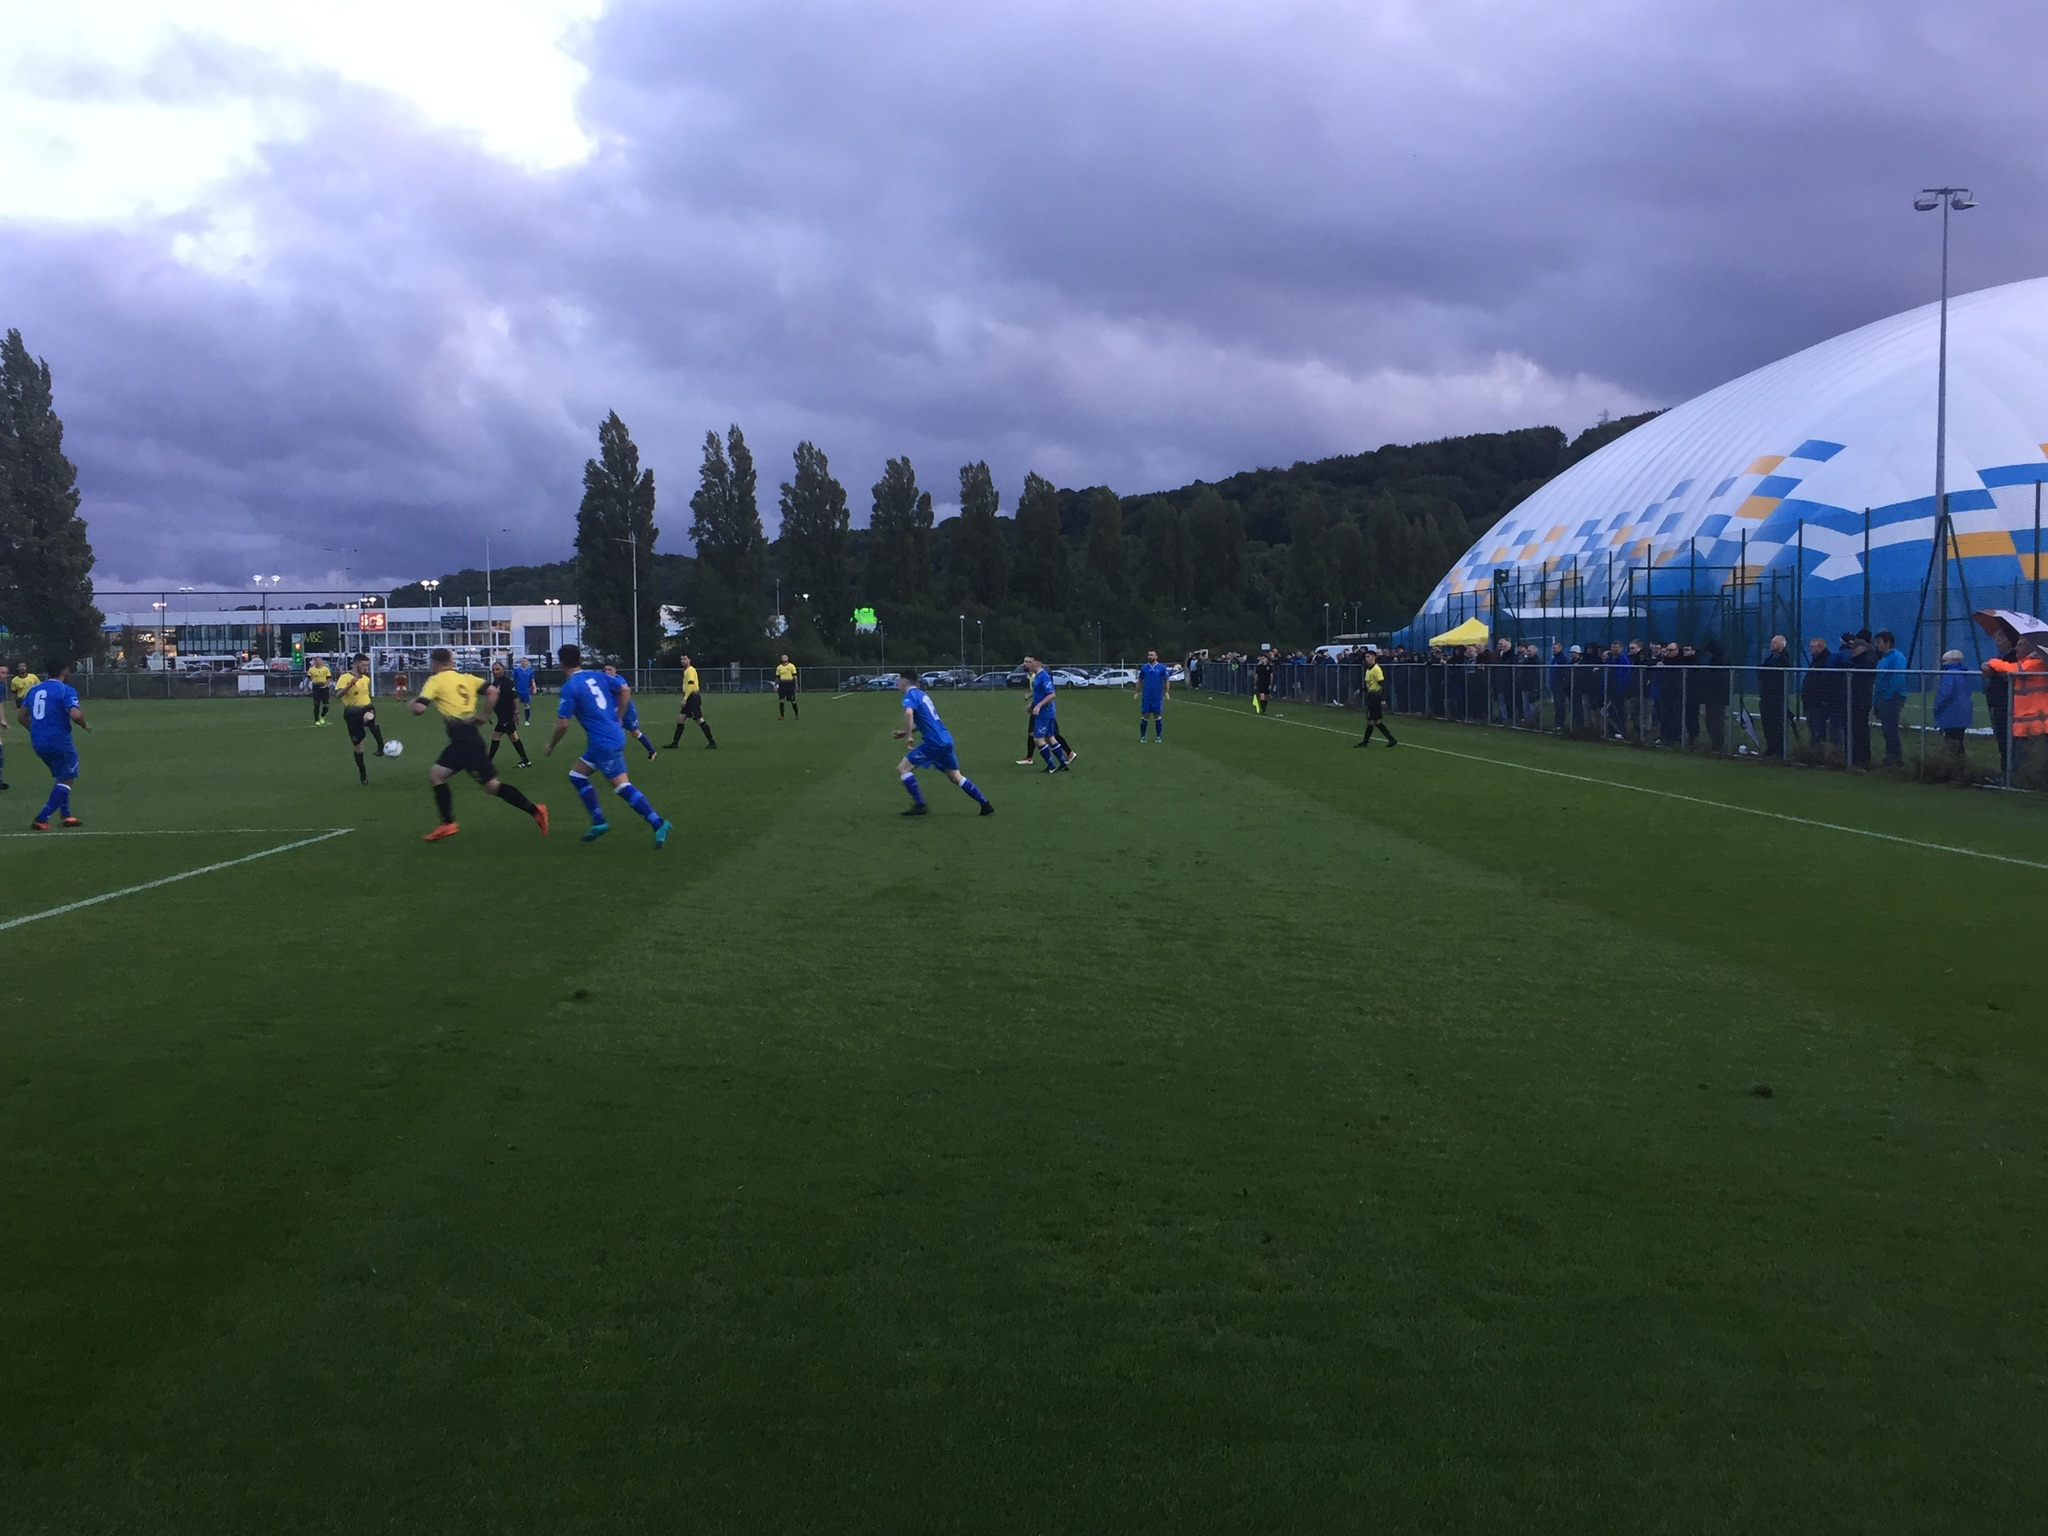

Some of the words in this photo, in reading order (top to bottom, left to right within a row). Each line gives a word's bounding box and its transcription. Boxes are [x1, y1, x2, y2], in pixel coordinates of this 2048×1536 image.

[360, 613, 384, 626] ScS
[303, 631, 323, 643] M&S
[33, 689, 48, 720] 6
[456, 683, 470, 706] 9
[585, 678, 607, 710] 5
